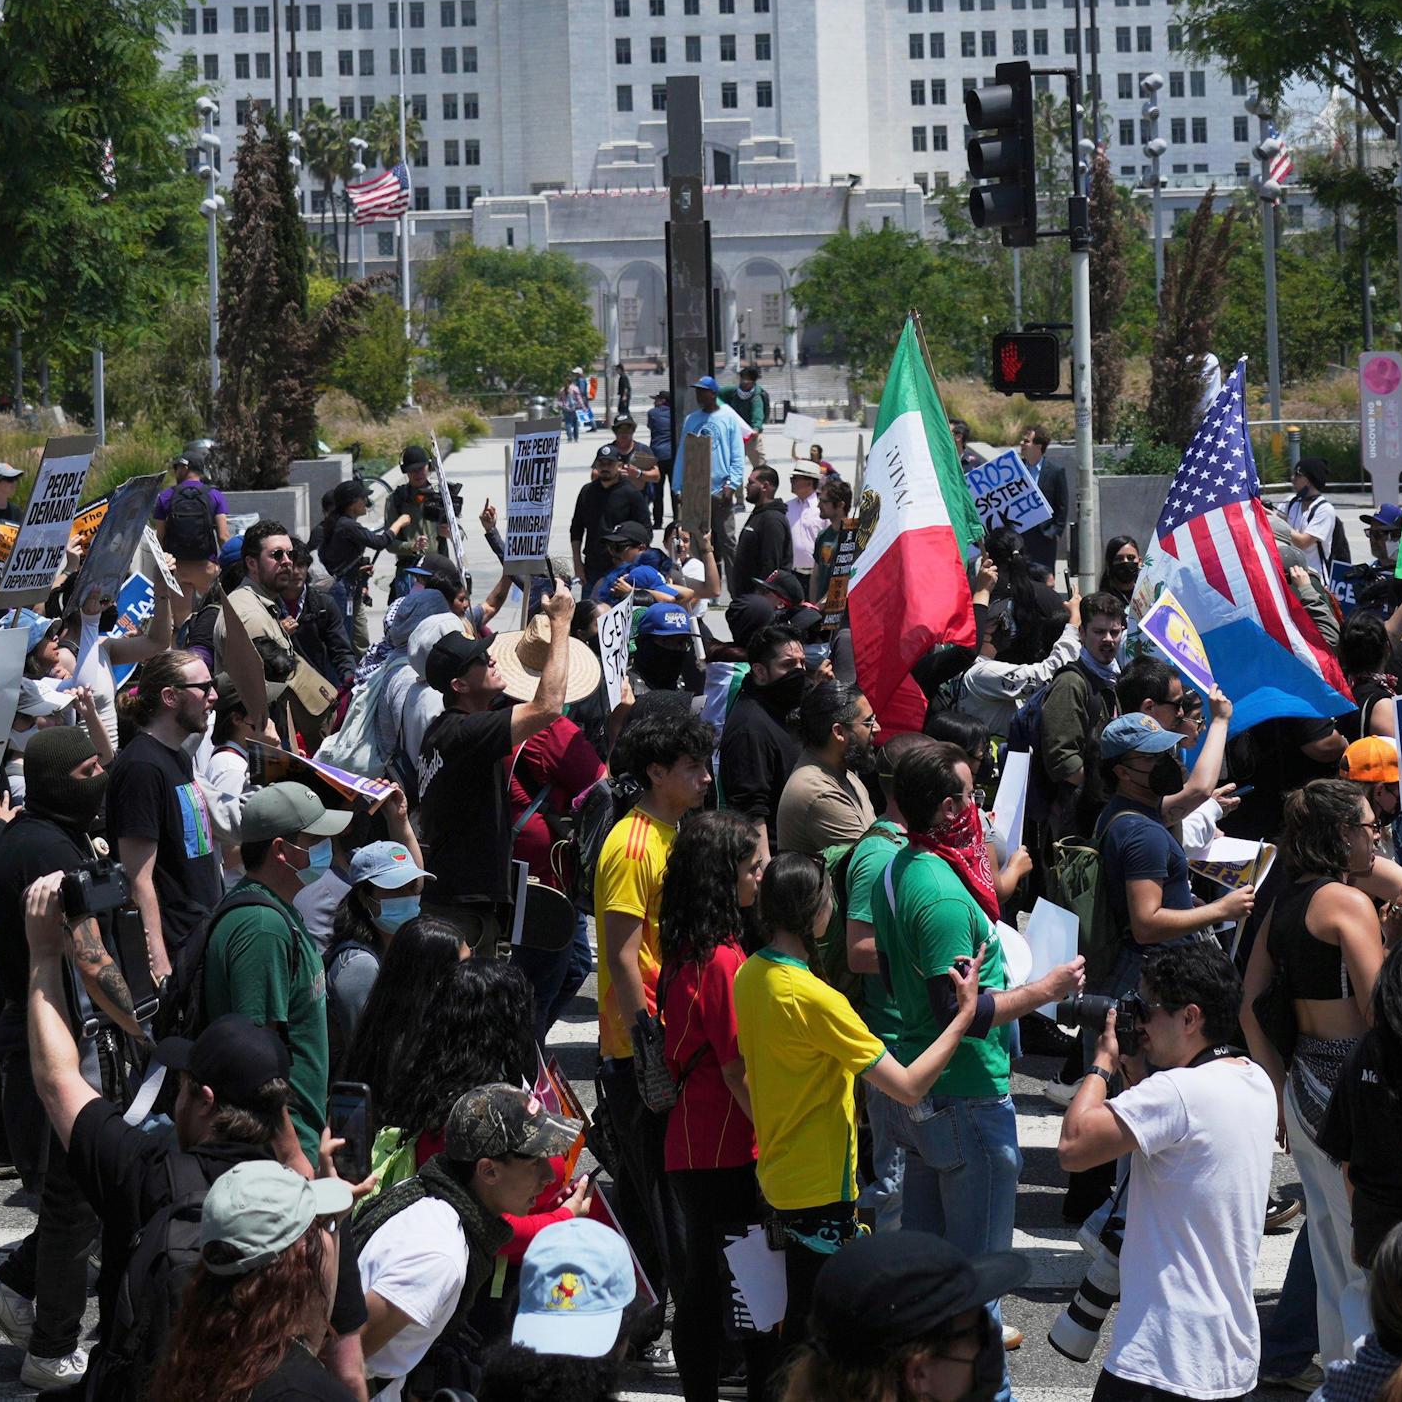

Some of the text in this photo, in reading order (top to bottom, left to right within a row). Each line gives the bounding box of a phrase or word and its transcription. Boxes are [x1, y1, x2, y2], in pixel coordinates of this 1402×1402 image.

[517, 436, 559, 457] THE PEOPLE
[43, 470, 86, 500] PEOPLE
[513, 456, 556, 487] UNITED
[975, 477, 1029, 514] SYSTEM
[1011, 490, 1044, 519] ICE
[82, 511, 103, 524] The
[11, 545, 65, 572] STOP THE
[1330, 579, 1357, 605] ICE
